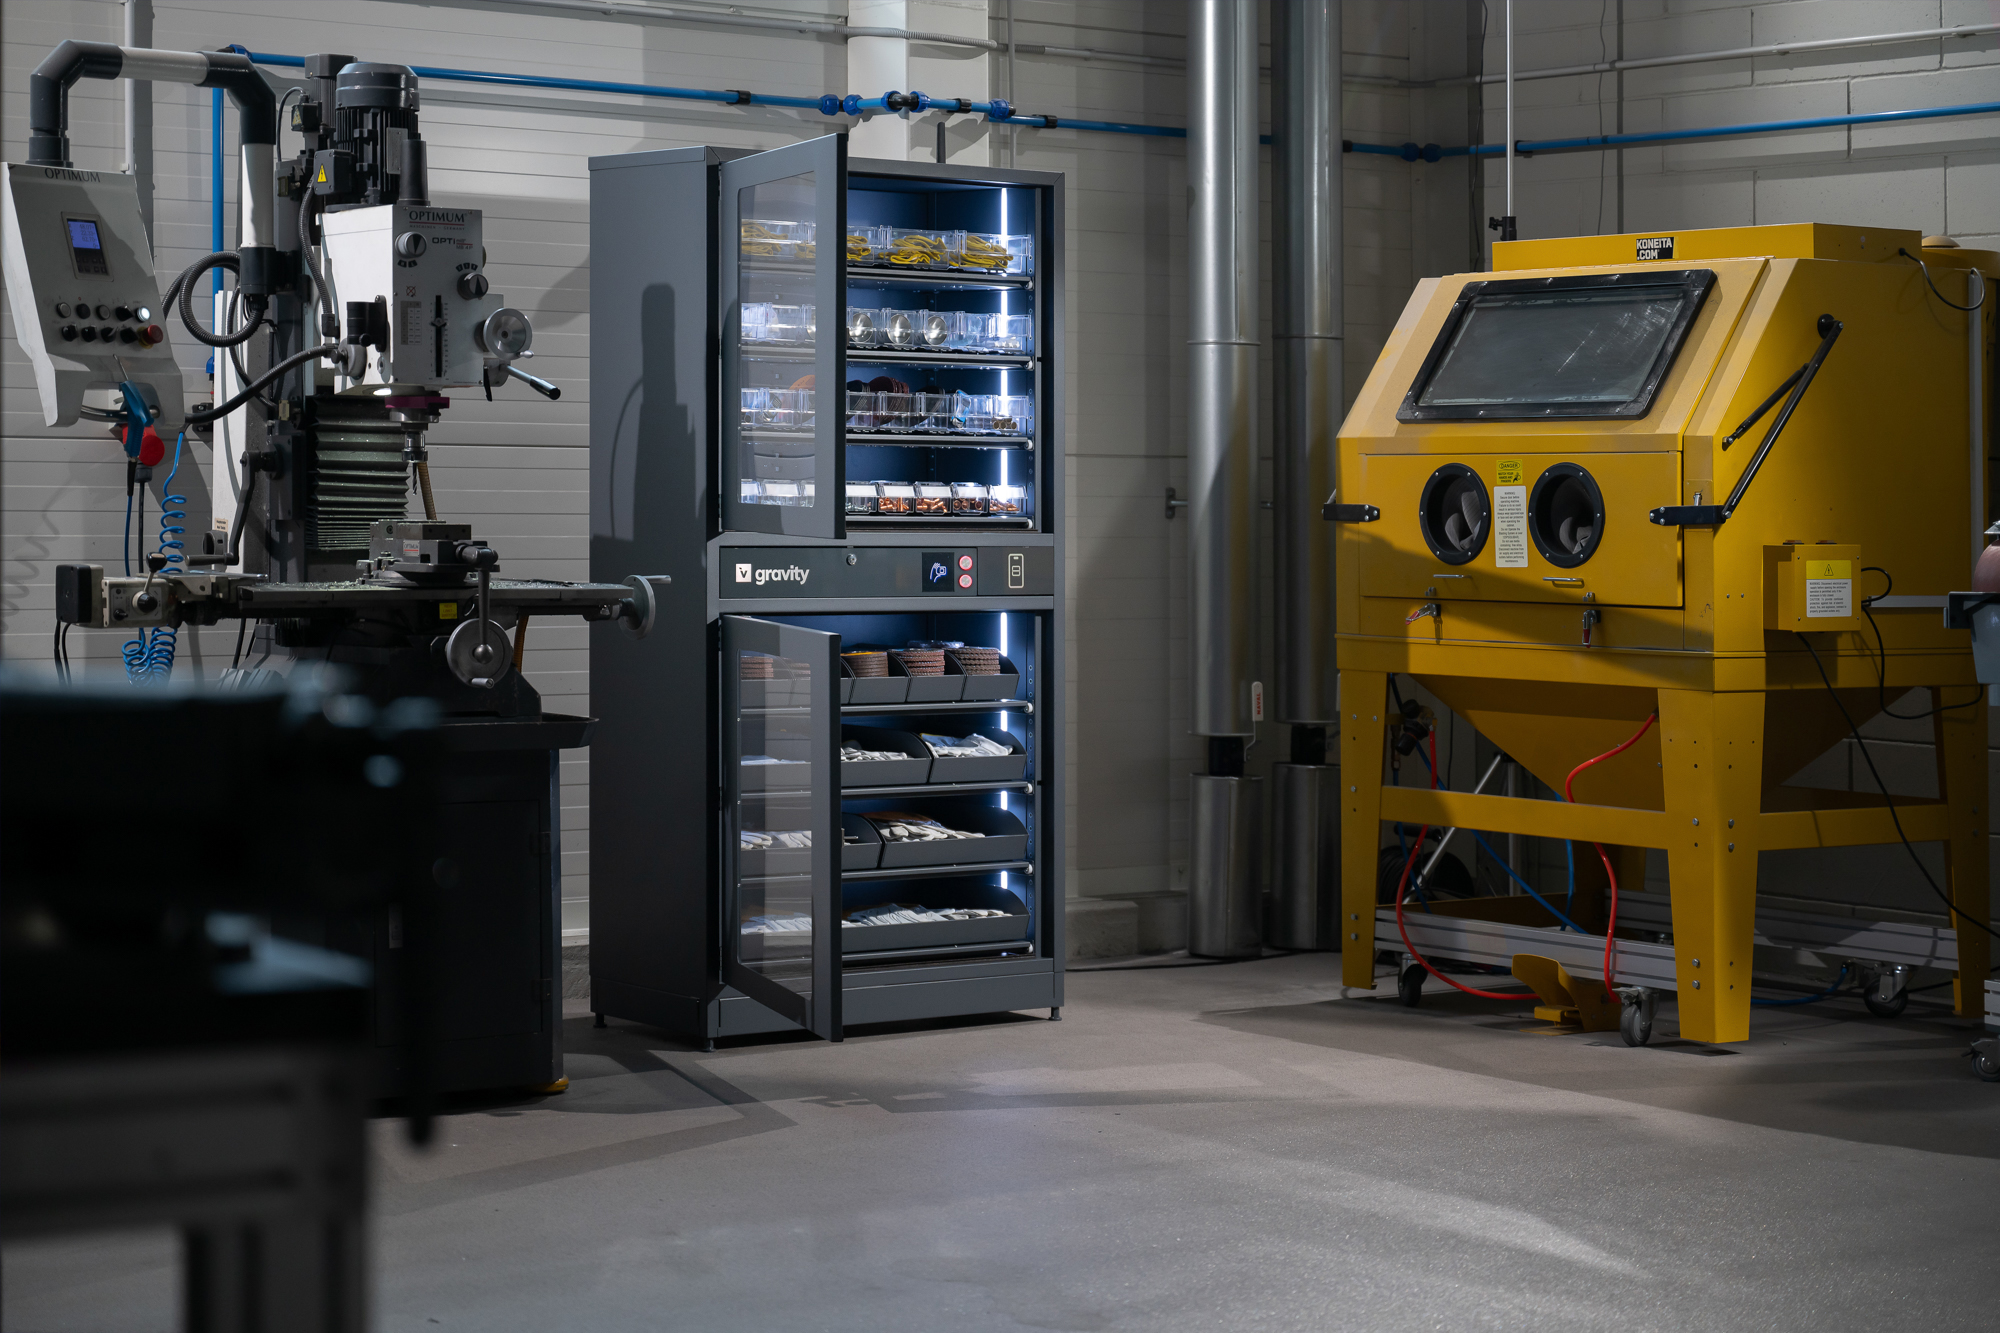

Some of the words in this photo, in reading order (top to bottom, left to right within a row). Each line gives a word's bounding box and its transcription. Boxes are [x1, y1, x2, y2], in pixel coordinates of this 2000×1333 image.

[45, 167, 101, 183] OPTIMUM
[409, 210, 465, 223] OPTIMUM
[1636, 238, 1672, 249] KONEITA
[1637, 249, 1658, 260] .COM
[755, 565, 810, 585] gravity
